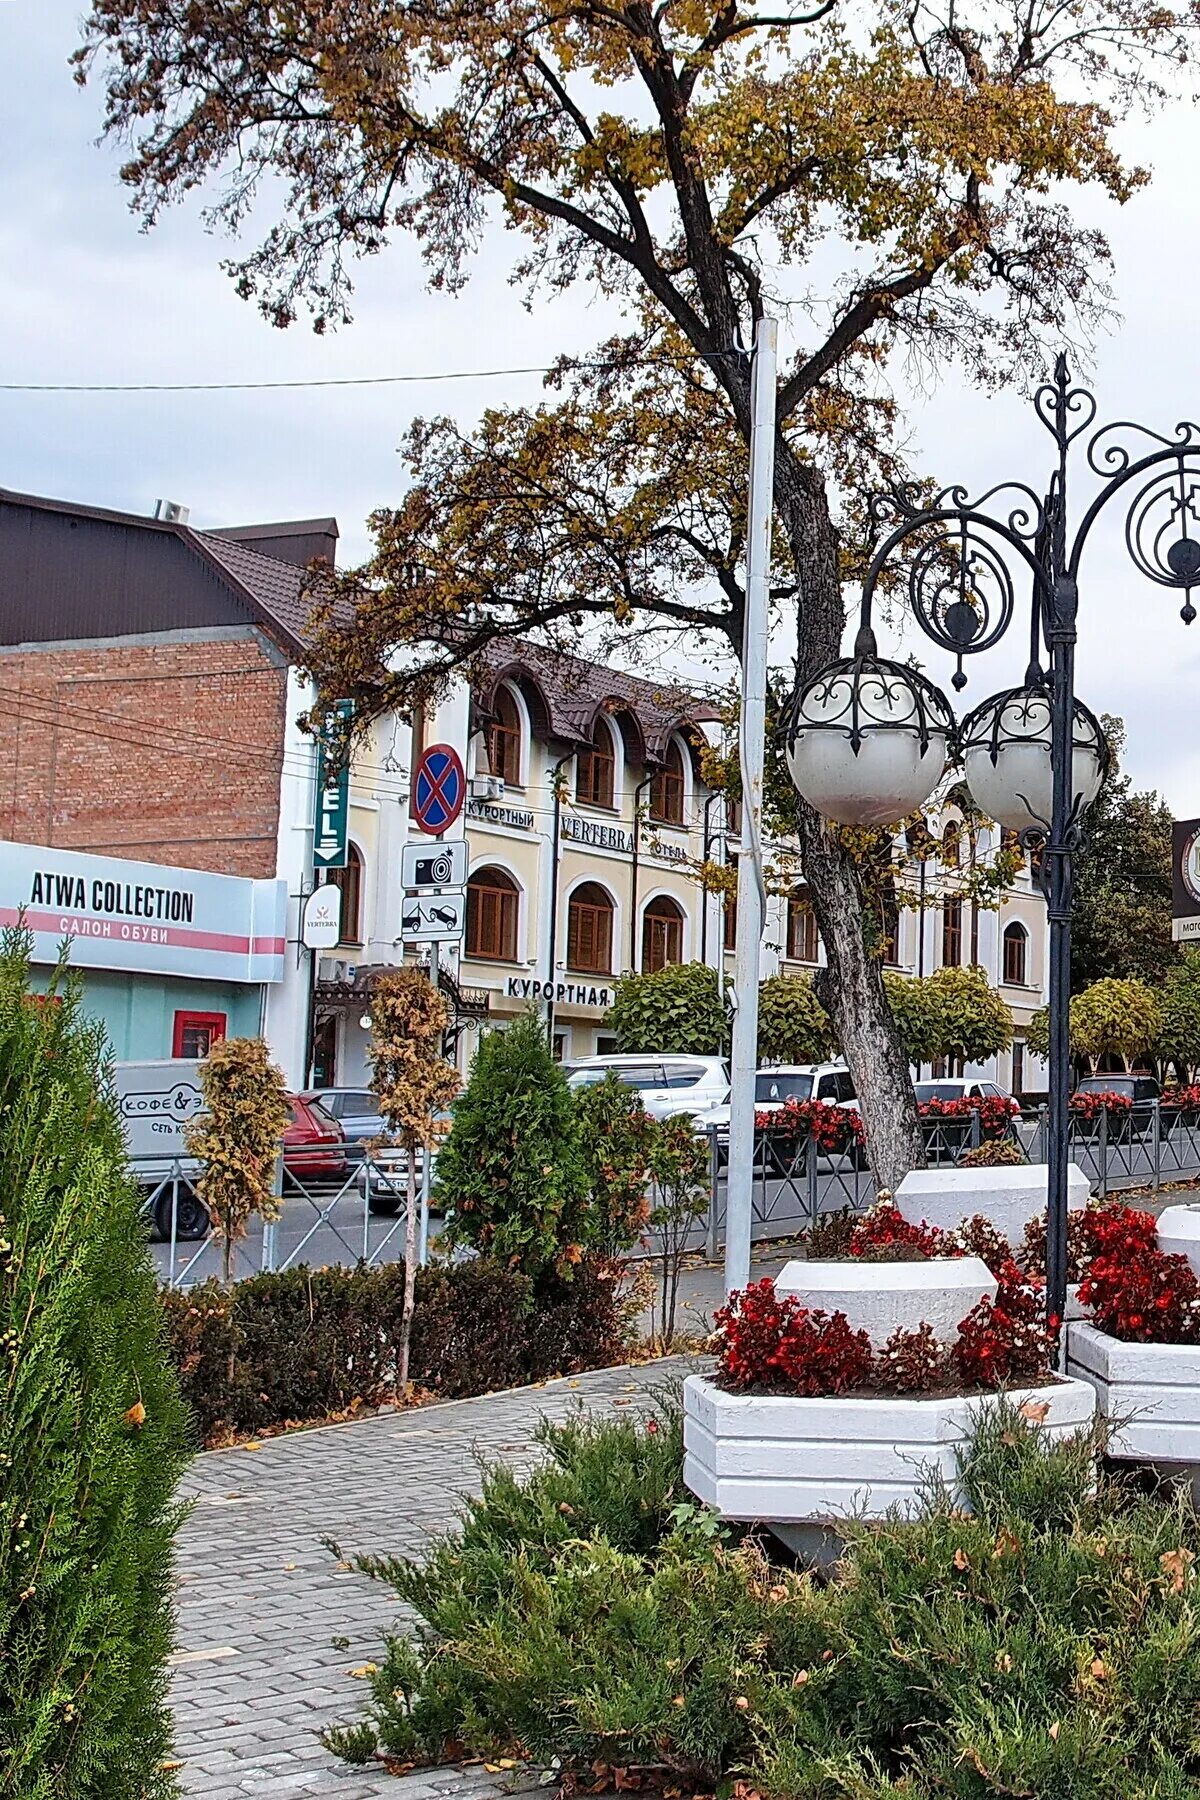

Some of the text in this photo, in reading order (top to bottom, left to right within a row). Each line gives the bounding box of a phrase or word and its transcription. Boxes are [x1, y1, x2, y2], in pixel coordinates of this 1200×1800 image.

[468, 801, 534, 828] КУРОРТНЫЙ
[561, 816, 635, 852] VERTEBRA
[31, 872, 193, 923] ATWA COLLECTION
[60, 917, 168, 943] САЛОН ОБУВИ
[507, 977, 609, 1007] КУРОРТНАЯ
[125, 1099, 172, 1111] КОФЕ
[151, 1122, 173, 1134] СЕТЬ
